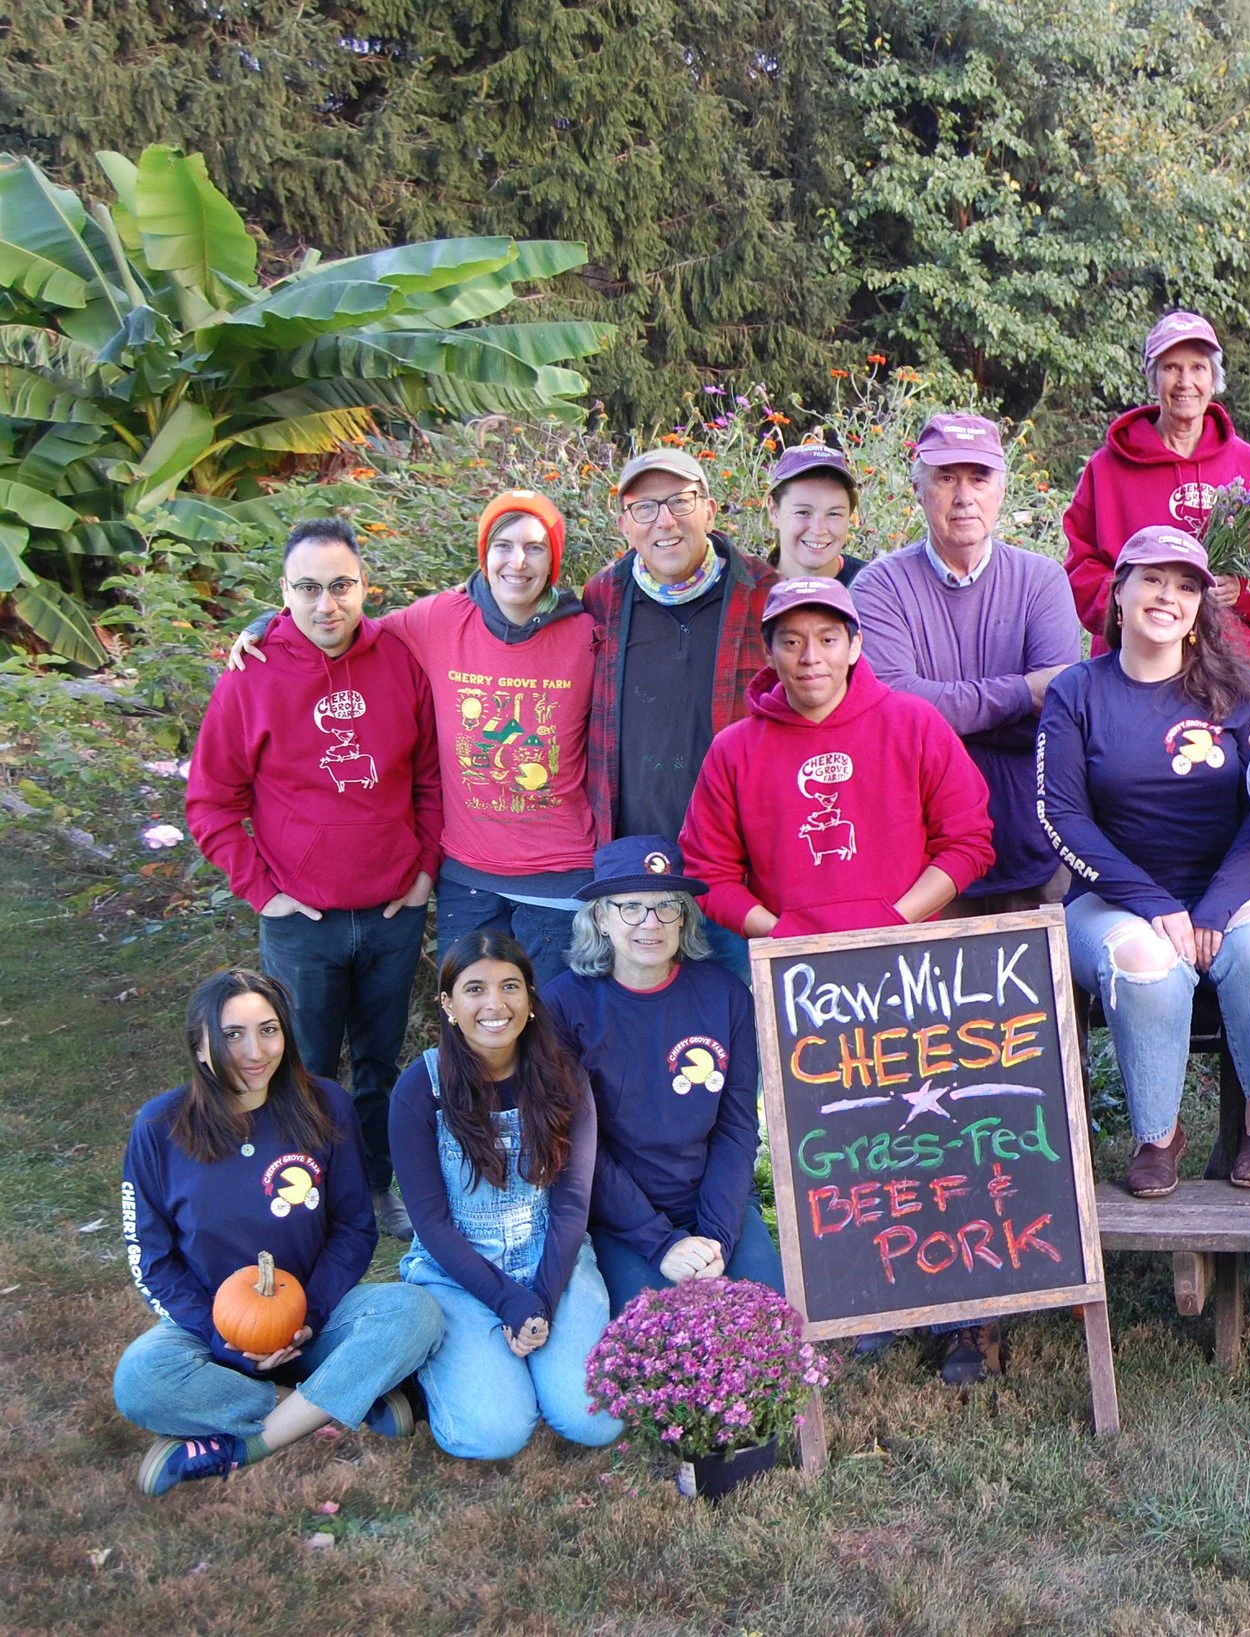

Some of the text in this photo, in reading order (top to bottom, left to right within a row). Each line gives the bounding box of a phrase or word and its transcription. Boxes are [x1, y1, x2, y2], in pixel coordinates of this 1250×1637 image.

[448, 670, 571, 689] CHERRY GROVE FARM
[802, 754, 848, 776] CHERRY
[815, 766, 849, 776] GROVE
[1036, 732, 1047, 796] CHERRY
[1059, 846, 1099, 882] FARM
[790, 1013, 1047, 1088] CHEESE
[264, 1158, 282, 1184] CHERRY
[283, 1154, 305, 1164] GROVE
[798, 1104, 1060, 1178] Grass-Fed
[121, 1181, 139, 1242] CHERRY
[807, 1174, 968, 1240] BEEF
[874, 1213, 1061, 1284] PORK
